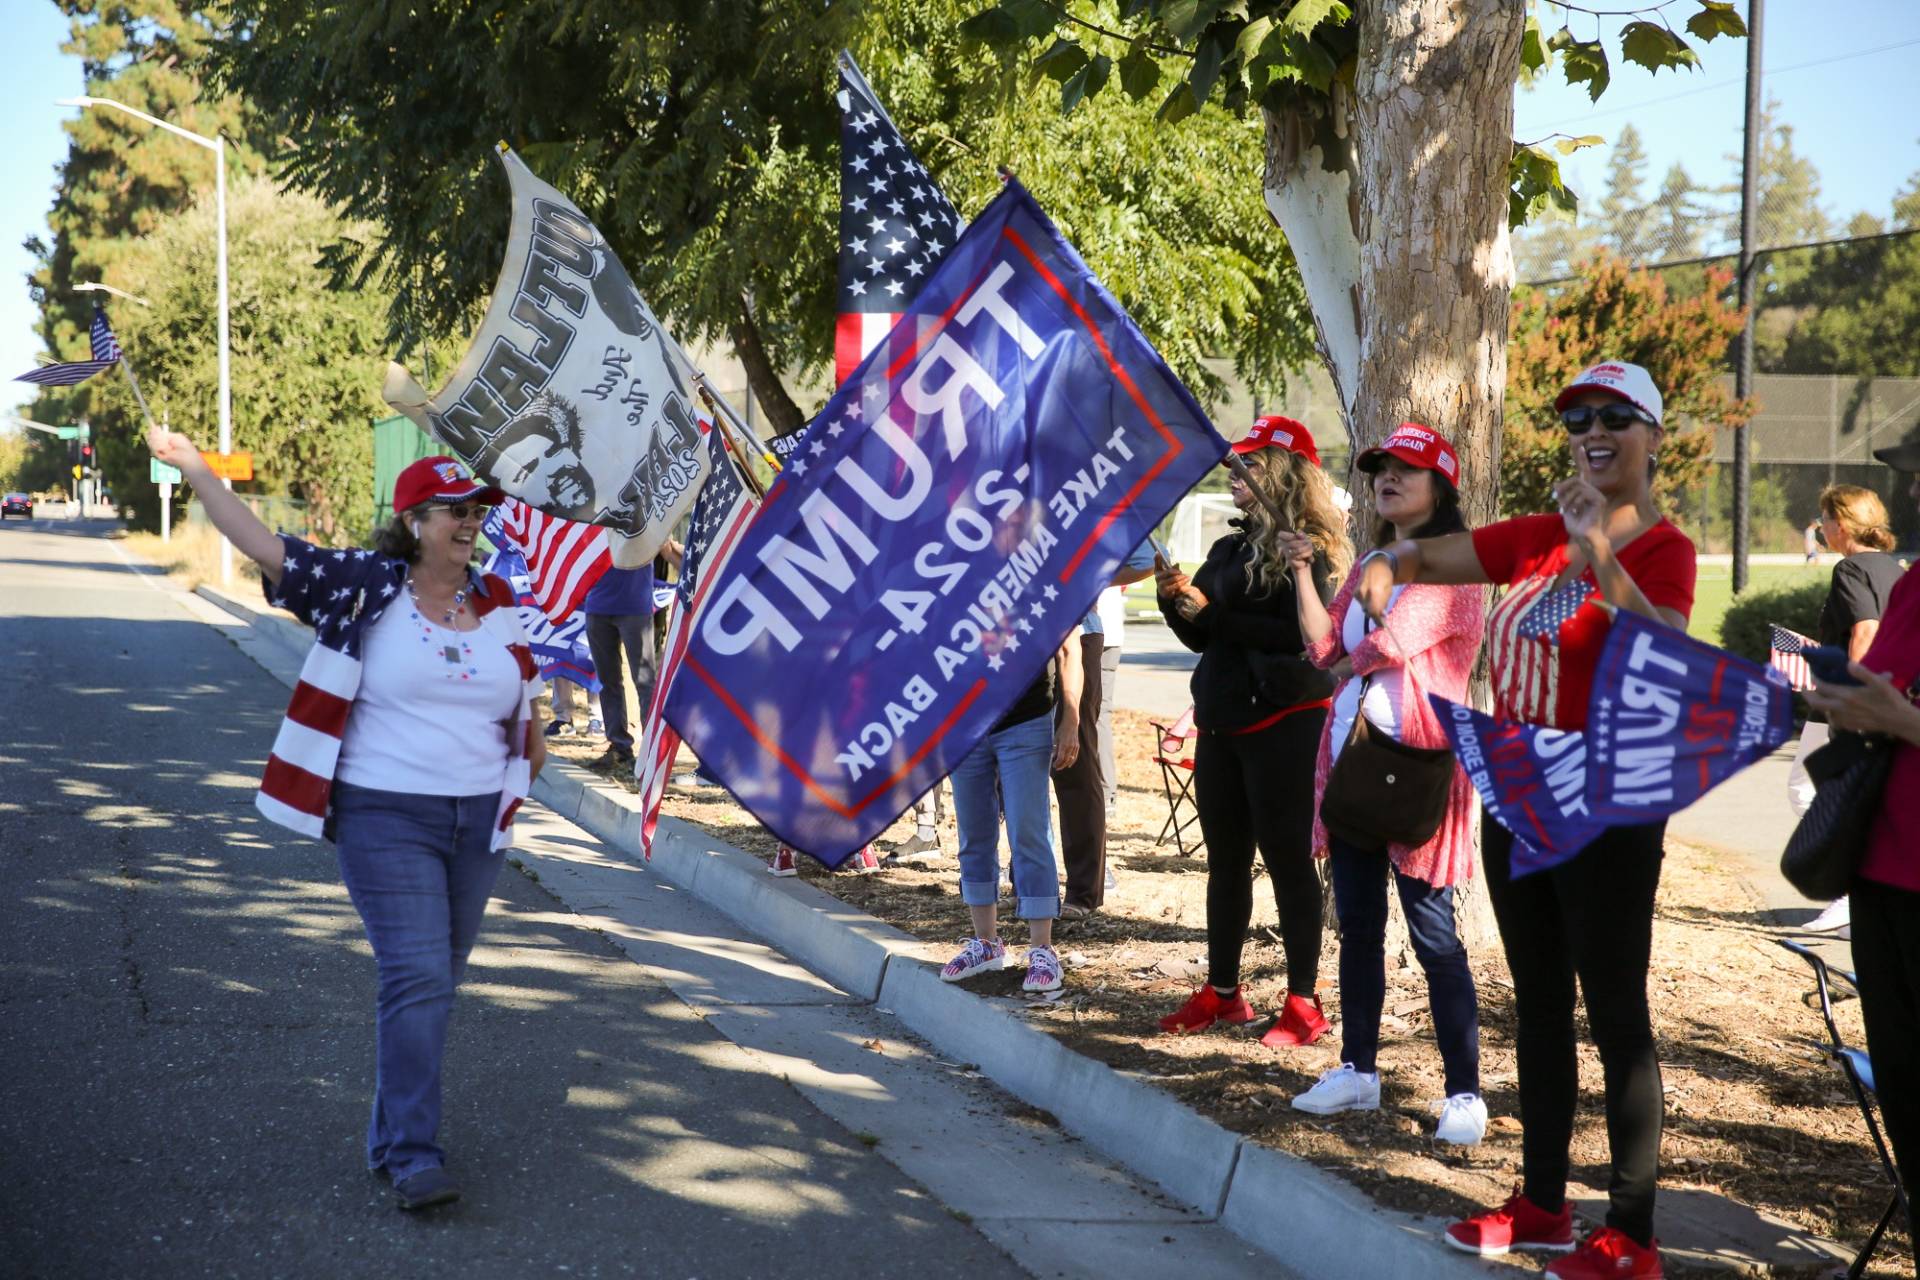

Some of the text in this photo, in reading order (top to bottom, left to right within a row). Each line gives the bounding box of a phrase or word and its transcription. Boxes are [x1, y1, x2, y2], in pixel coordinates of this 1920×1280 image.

[1396, 426, 1436, 443] AMERICA
[1397, 438, 1426, 453] AGAIN
[1455, 723, 1485, 772] MORE
